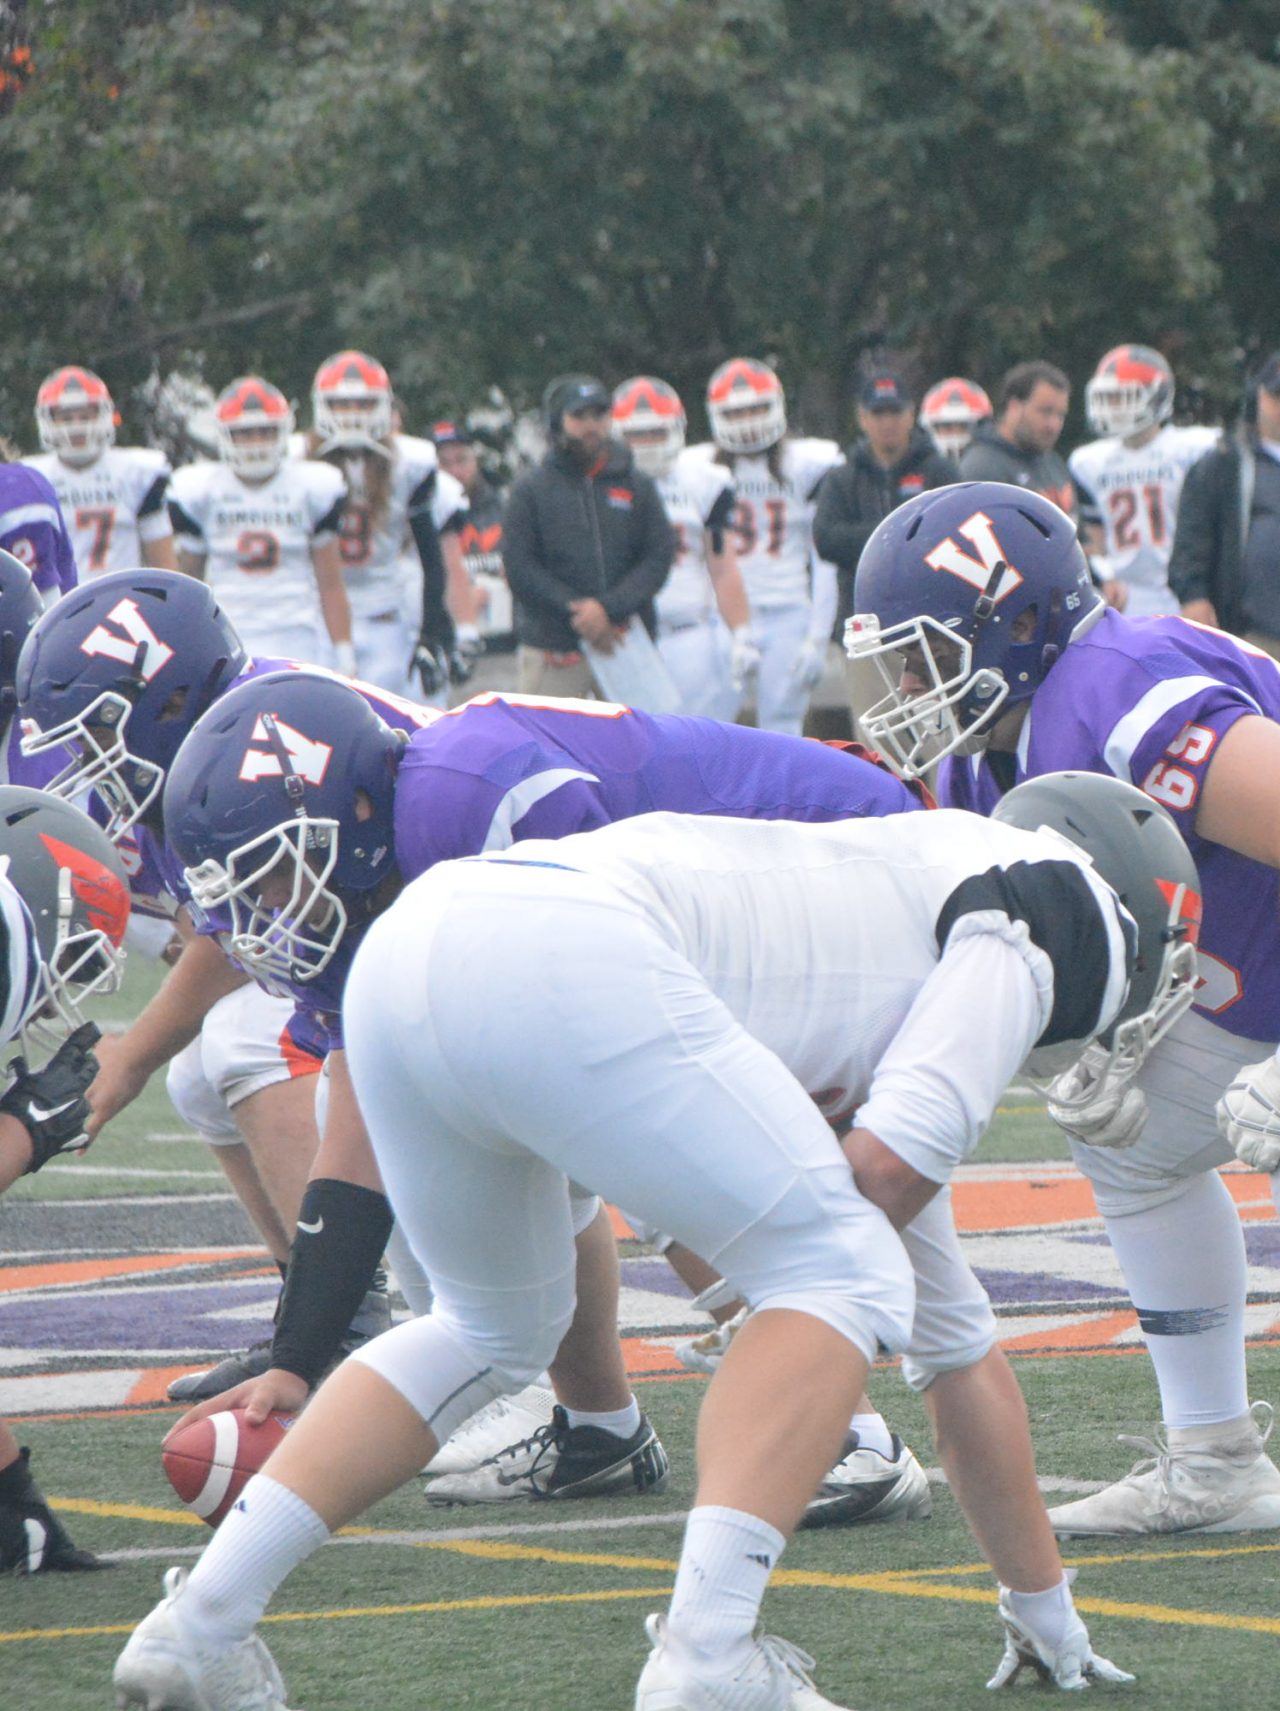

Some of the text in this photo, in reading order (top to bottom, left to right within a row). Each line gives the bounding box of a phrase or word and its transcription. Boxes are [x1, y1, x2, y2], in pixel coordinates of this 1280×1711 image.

[75, 508, 118, 572] 7
[1109, 484, 1166, 550] 21
[924, 511, 1025, 604] V
[1066, 591, 1081, 610] 65
[80, 597, 176, 682] V
[1142, 720, 1217, 812] 65
